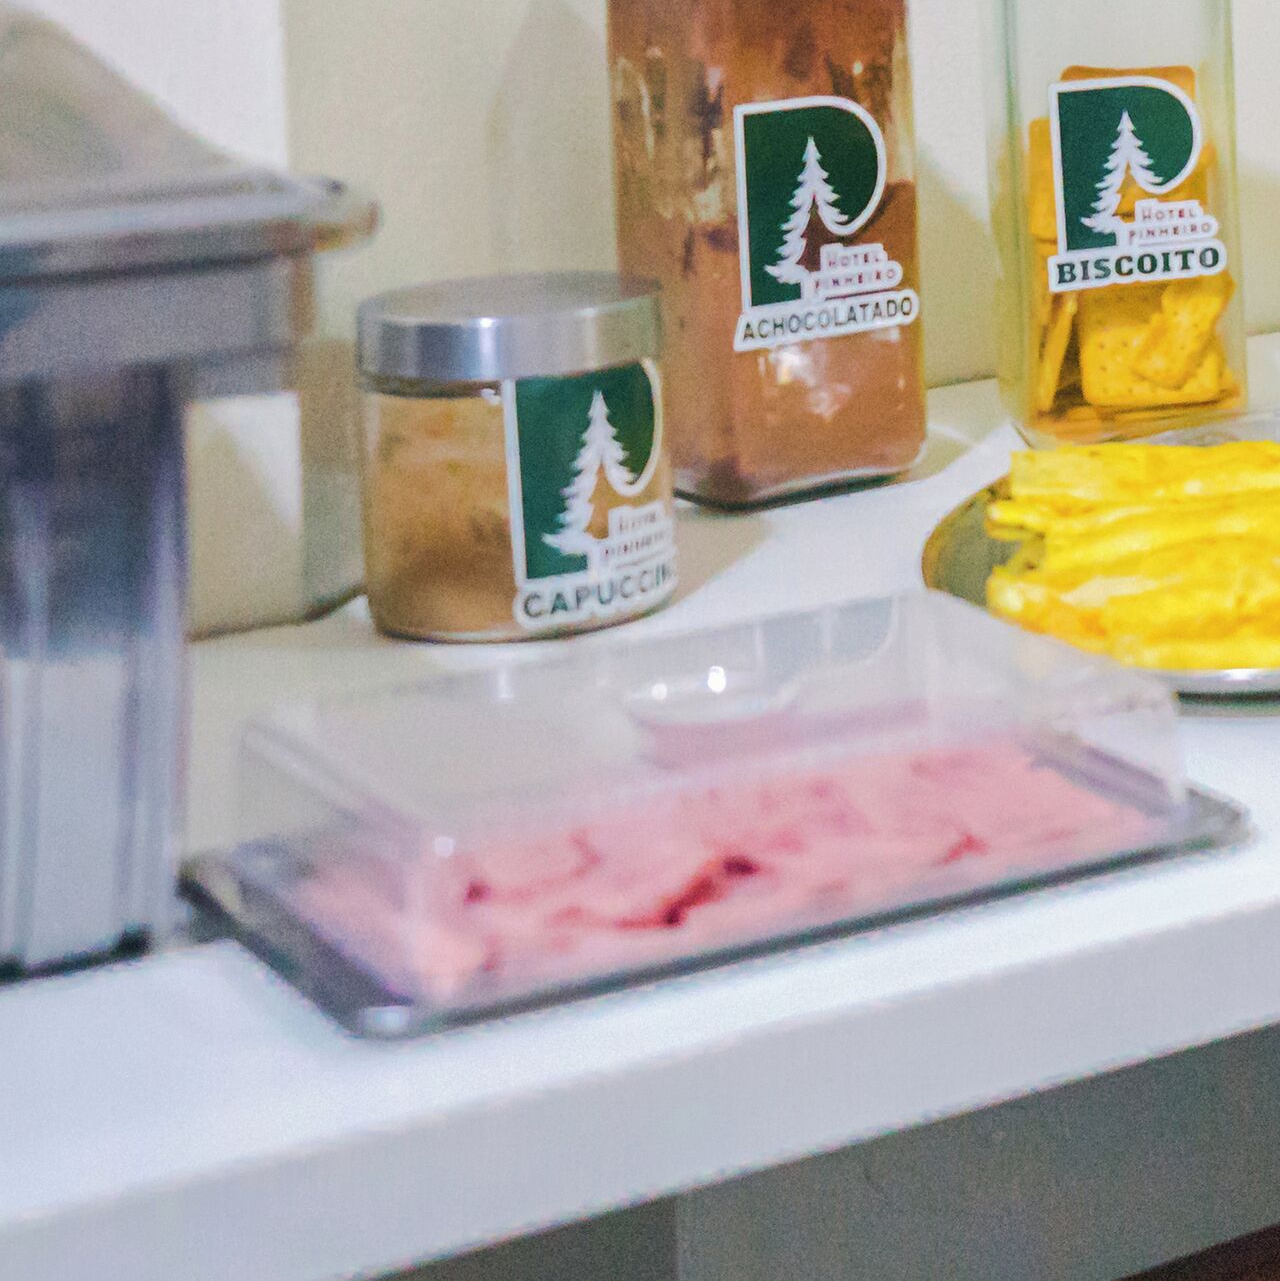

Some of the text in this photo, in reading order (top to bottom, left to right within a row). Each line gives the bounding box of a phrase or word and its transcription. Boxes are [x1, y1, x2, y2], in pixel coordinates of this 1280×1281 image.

[1056, 247, 1220, 285] BISCOITO
[743, 297, 912, 341] ACHOCOLATADO
[523, 563, 672, 617] CAPUCCIN
